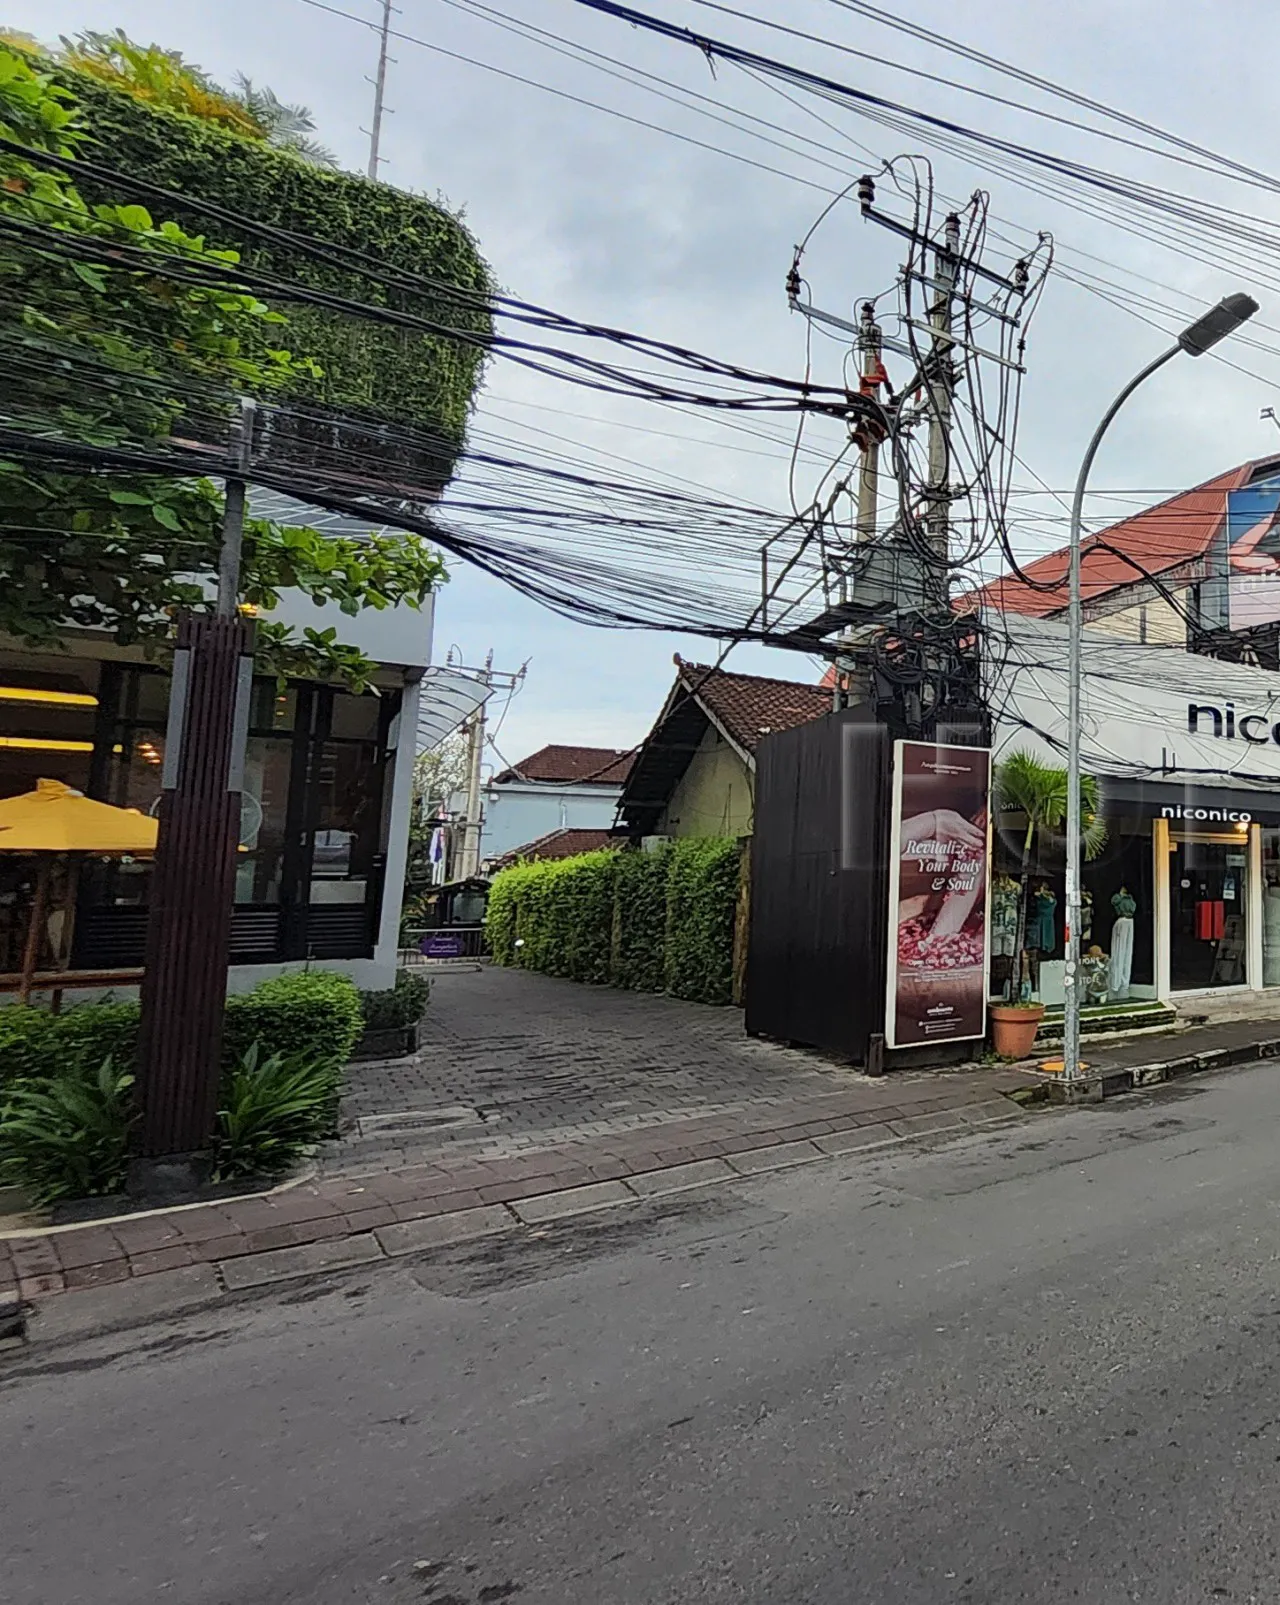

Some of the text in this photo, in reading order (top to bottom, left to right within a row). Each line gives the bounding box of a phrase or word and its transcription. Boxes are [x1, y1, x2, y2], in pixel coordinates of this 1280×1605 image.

[1161, 804, 1252, 823] niconico
[906, 840, 968, 855] Revitalize
[918, 858, 981, 875] Your Body
[931, 876, 974, 891] & Soul
